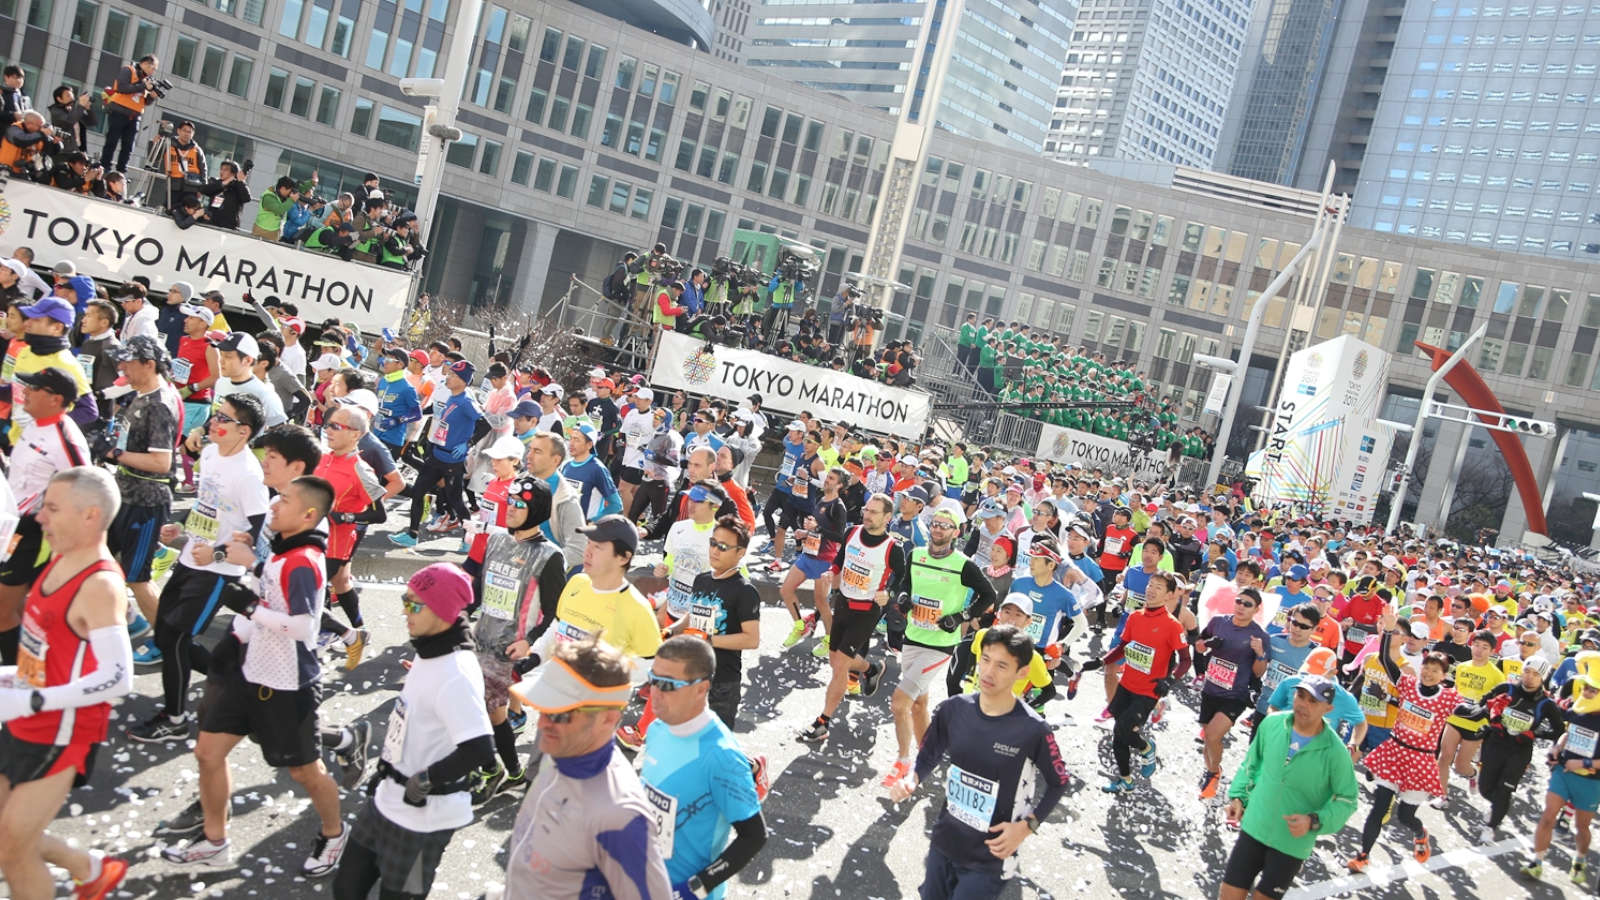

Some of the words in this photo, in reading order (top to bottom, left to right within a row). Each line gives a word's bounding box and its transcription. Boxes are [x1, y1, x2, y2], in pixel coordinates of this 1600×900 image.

[22, 208, 165, 266] TOKYO
[175, 245, 374, 313] MARATHON
[721, 361, 794, 397] TOKYO
[800, 379, 908, 423] MARATHON
[1070, 440, 1110, 463] TOKYO
[1111, 450, 1165, 475] MARATHO
[1268, 401, 1296, 463] START
[948, 779, 987, 813] C21182
